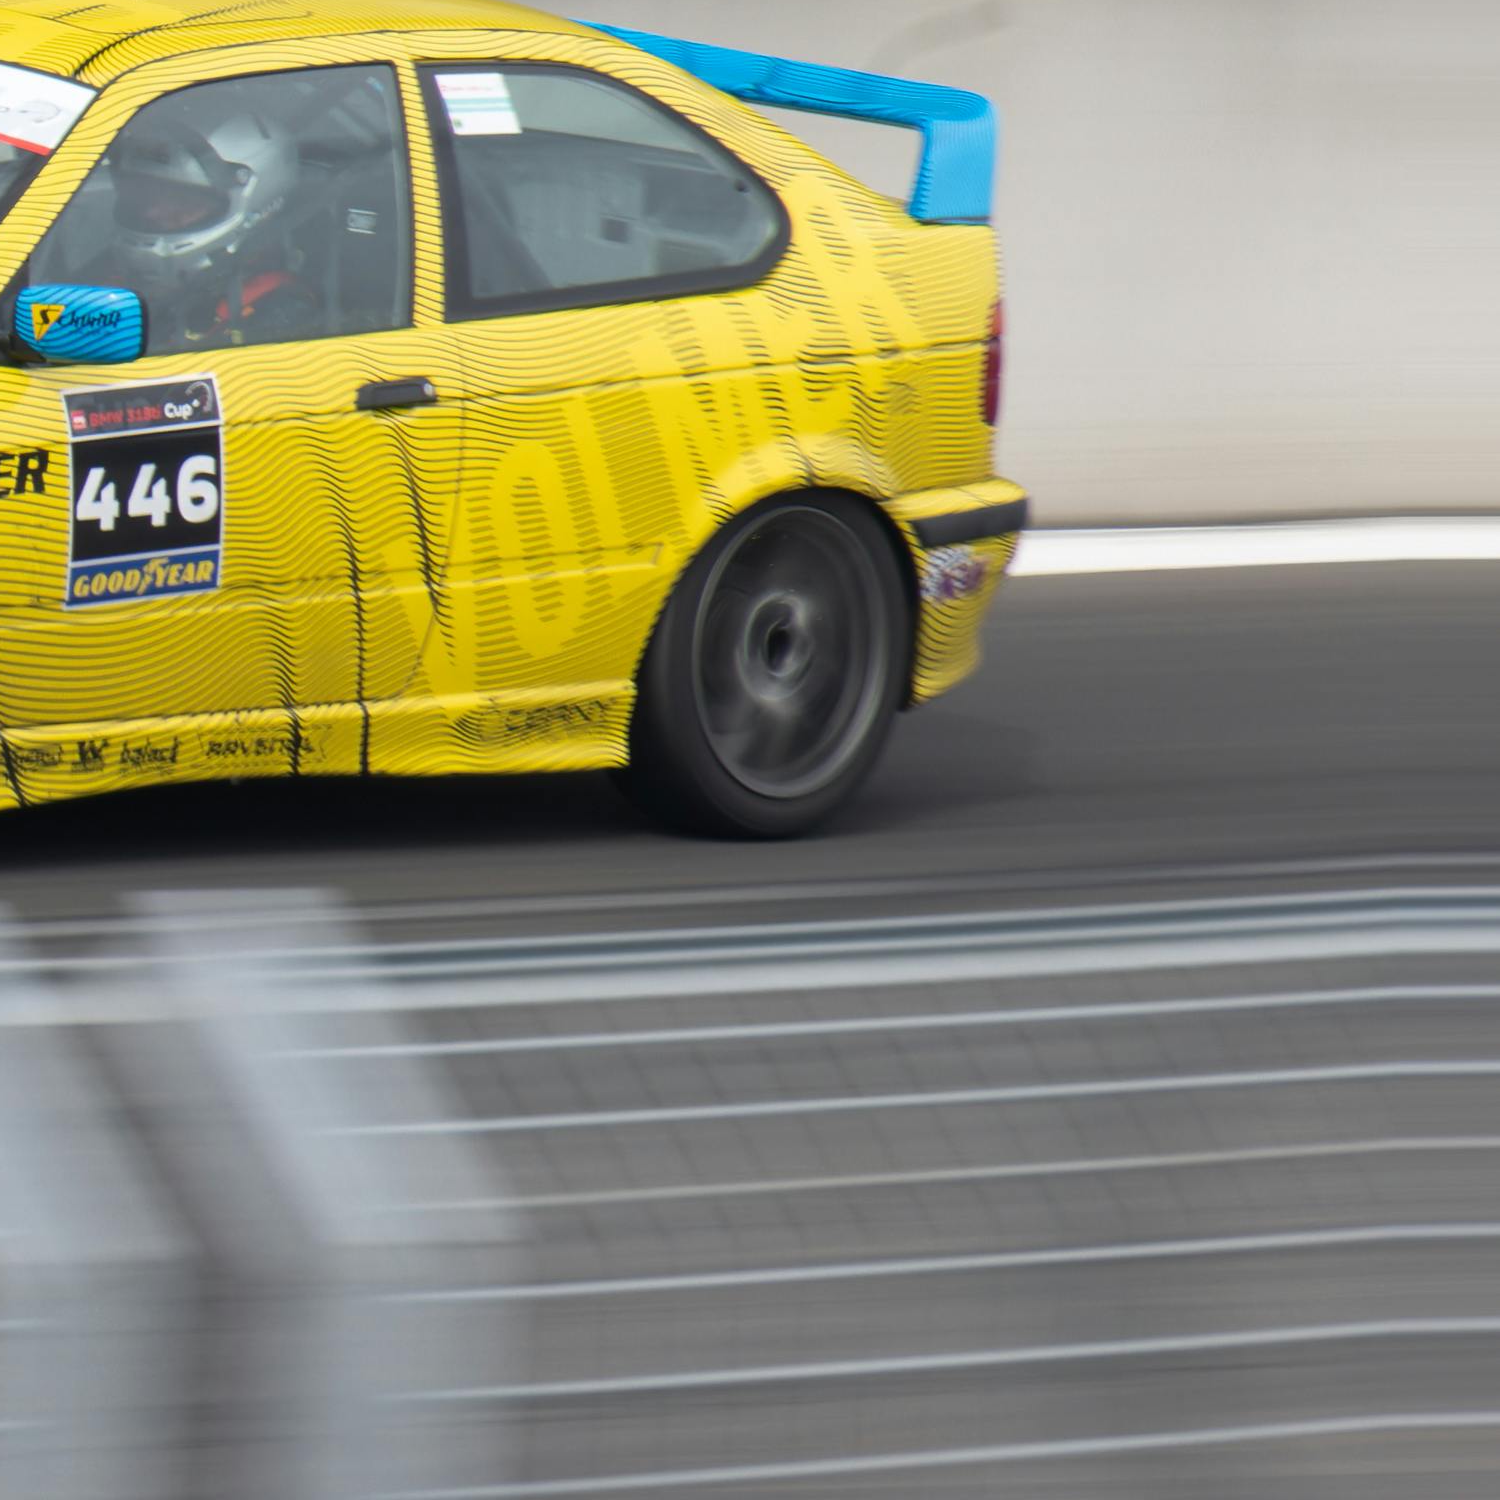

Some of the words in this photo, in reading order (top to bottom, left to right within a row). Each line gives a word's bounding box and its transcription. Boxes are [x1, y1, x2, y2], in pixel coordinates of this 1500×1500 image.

[88, 409, 124, 428] BMW
[164, 402, 194, 421] Cup
[75, 453, 219, 532] 446
[73, 557, 215, 598] GOODYEAR
